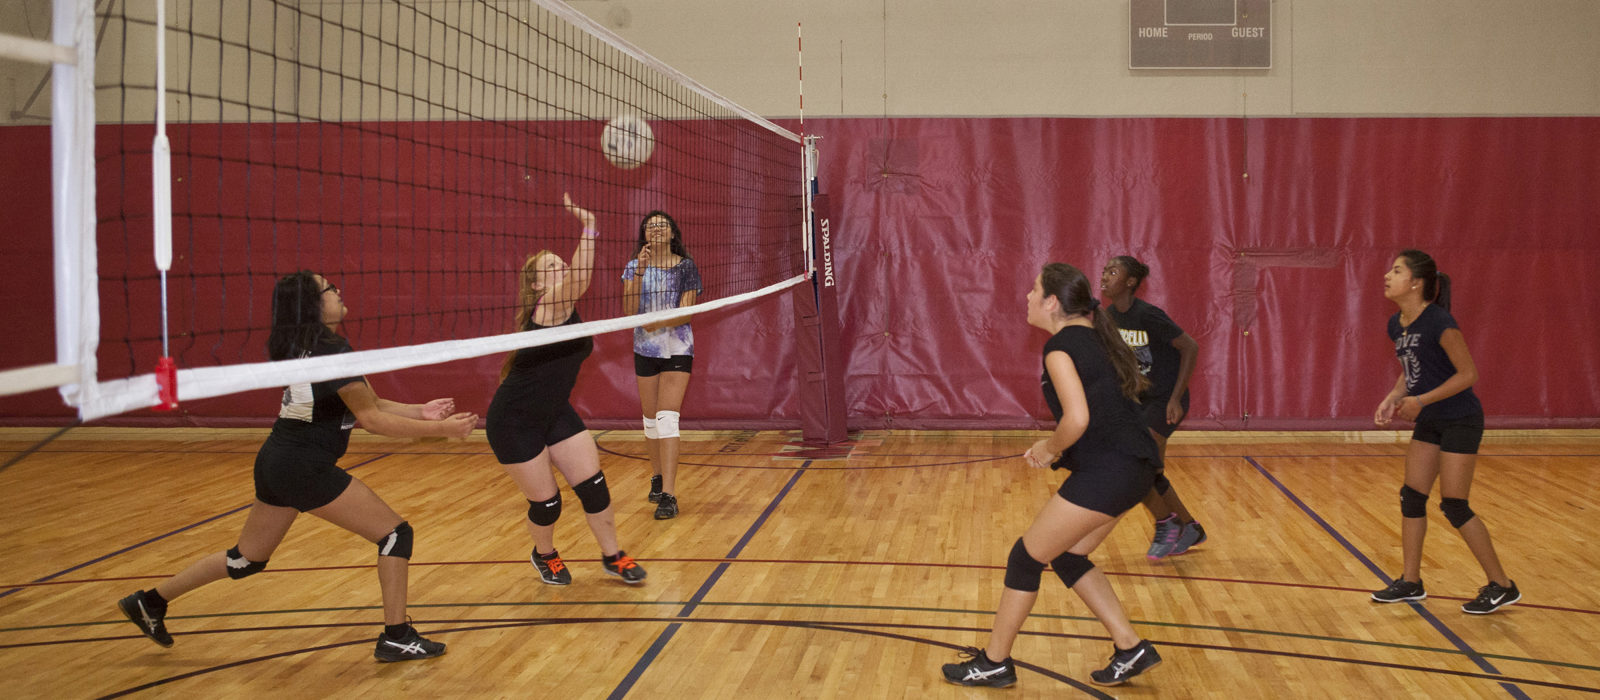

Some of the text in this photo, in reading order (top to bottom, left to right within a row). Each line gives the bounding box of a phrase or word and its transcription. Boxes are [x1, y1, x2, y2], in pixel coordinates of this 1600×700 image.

[1138, 27, 1168, 38] HOME
[1188, 33, 1213, 41] PERIOD
[1231, 27, 1265, 38] GUEST
[820, 218, 835, 287] SPALDING
[1395, 333, 1421, 350] OVE
